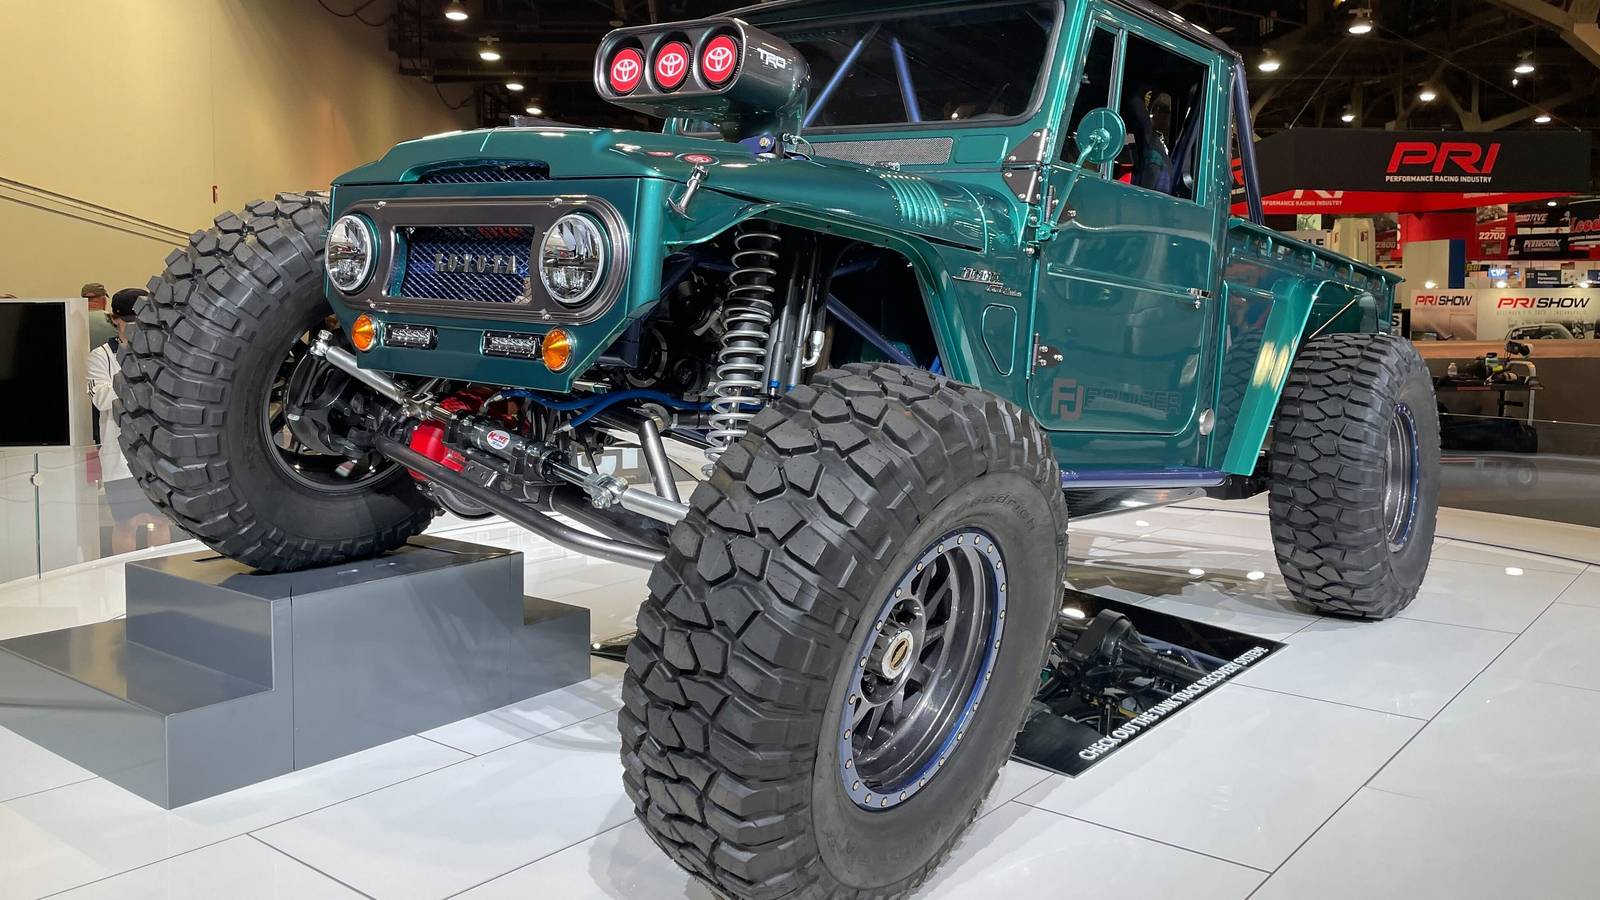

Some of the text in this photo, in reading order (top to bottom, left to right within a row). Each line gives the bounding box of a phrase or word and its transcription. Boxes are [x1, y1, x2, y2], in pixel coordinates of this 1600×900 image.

[757, 48, 786, 69] TRD
[1386, 142, 1501, 174] PRI
[1478, 231, 1506, 240] 22700
[434, 253, 517, 274] TOYOTA
[1415, 295, 1473, 306] PRI SHOW
[1497, 297, 1590, 309] PRI SHOW
[1050, 377, 1085, 421] FJ
[1078, 734, 1122, 760] CHECK
[1112, 722, 1141, 740] OUT
[1130, 710, 1160, 727] THE
[1148, 697, 1182, 716] TANK
[1171, 681, 1205, 703] TRACK
